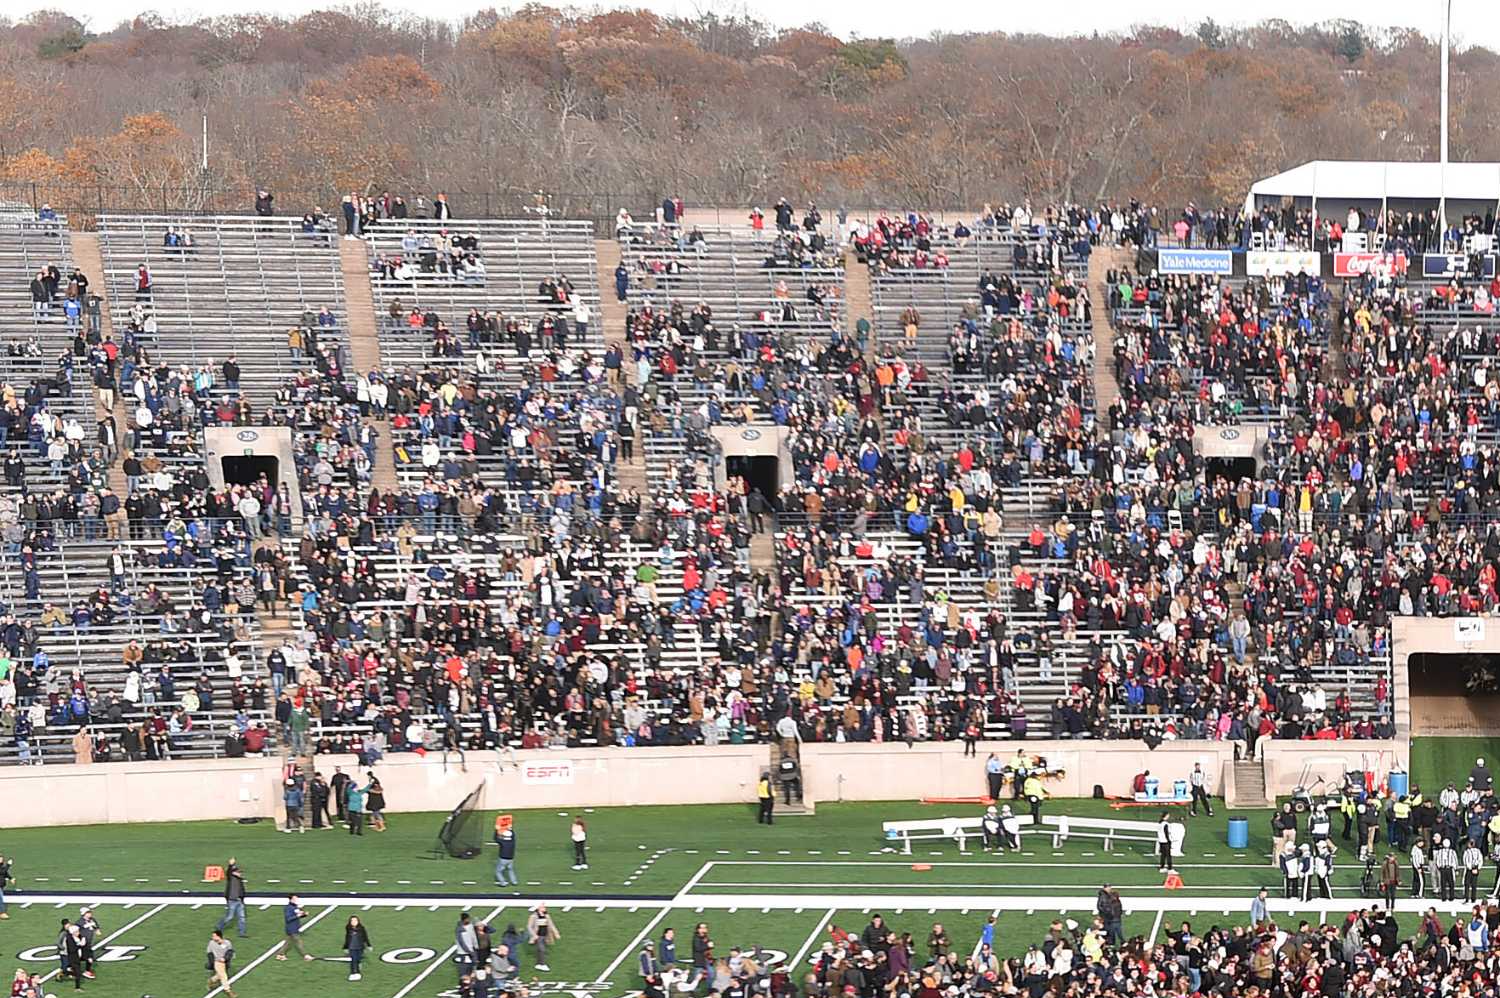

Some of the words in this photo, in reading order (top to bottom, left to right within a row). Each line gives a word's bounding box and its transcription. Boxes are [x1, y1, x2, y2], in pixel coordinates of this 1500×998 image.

[1162, 255, 1184, 268] Yale
[1185, 255, 1229, 269] Medicine
[526, 766, 570, 778] ESPN
